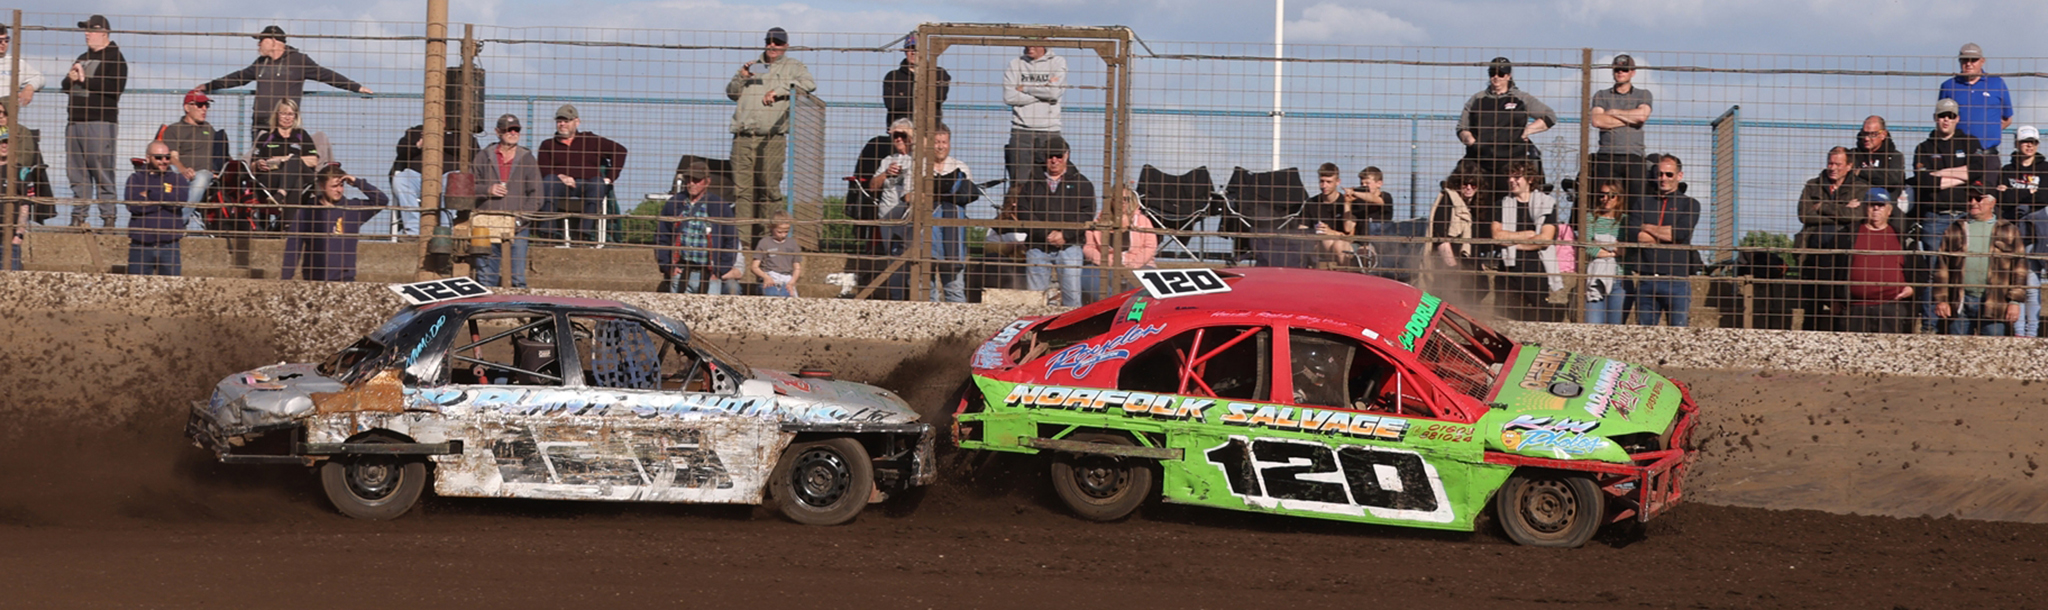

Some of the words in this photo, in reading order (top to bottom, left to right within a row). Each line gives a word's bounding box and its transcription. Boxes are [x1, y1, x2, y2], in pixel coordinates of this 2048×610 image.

[401, 278, 487, 302] 126
[1142, 270, 1224, 294] 120
[1004, 384, 1217, 424] NORFOLK
[1220, 402, 1411, 441] SALVAGE
[1516, 429, 1610, 454] Photos
[1204, 436, 1441, 514] 120
